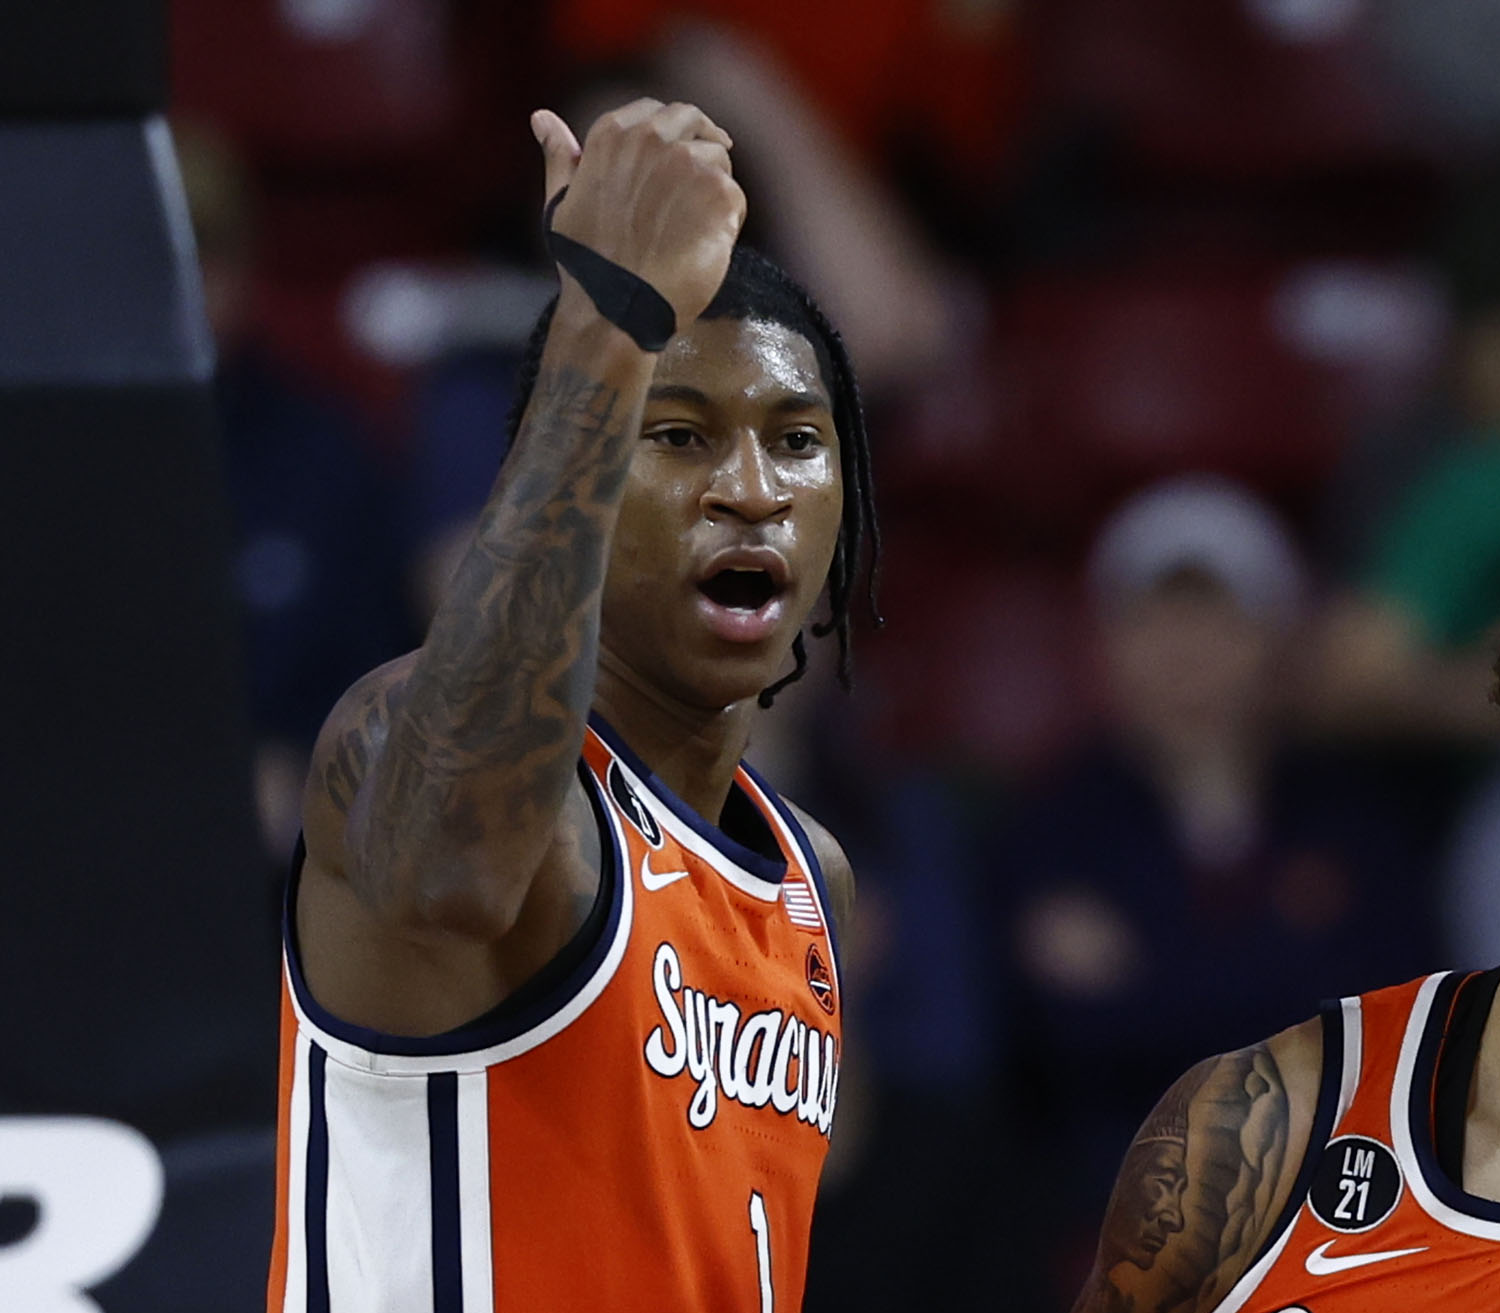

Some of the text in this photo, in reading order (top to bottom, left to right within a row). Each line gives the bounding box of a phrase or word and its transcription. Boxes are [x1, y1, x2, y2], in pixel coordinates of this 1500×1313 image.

[645, 941, 838, 1138] Syracus
[1342, 1147, 1375, 1178] LM
[1334, 1179, 1370, 1220] 21
